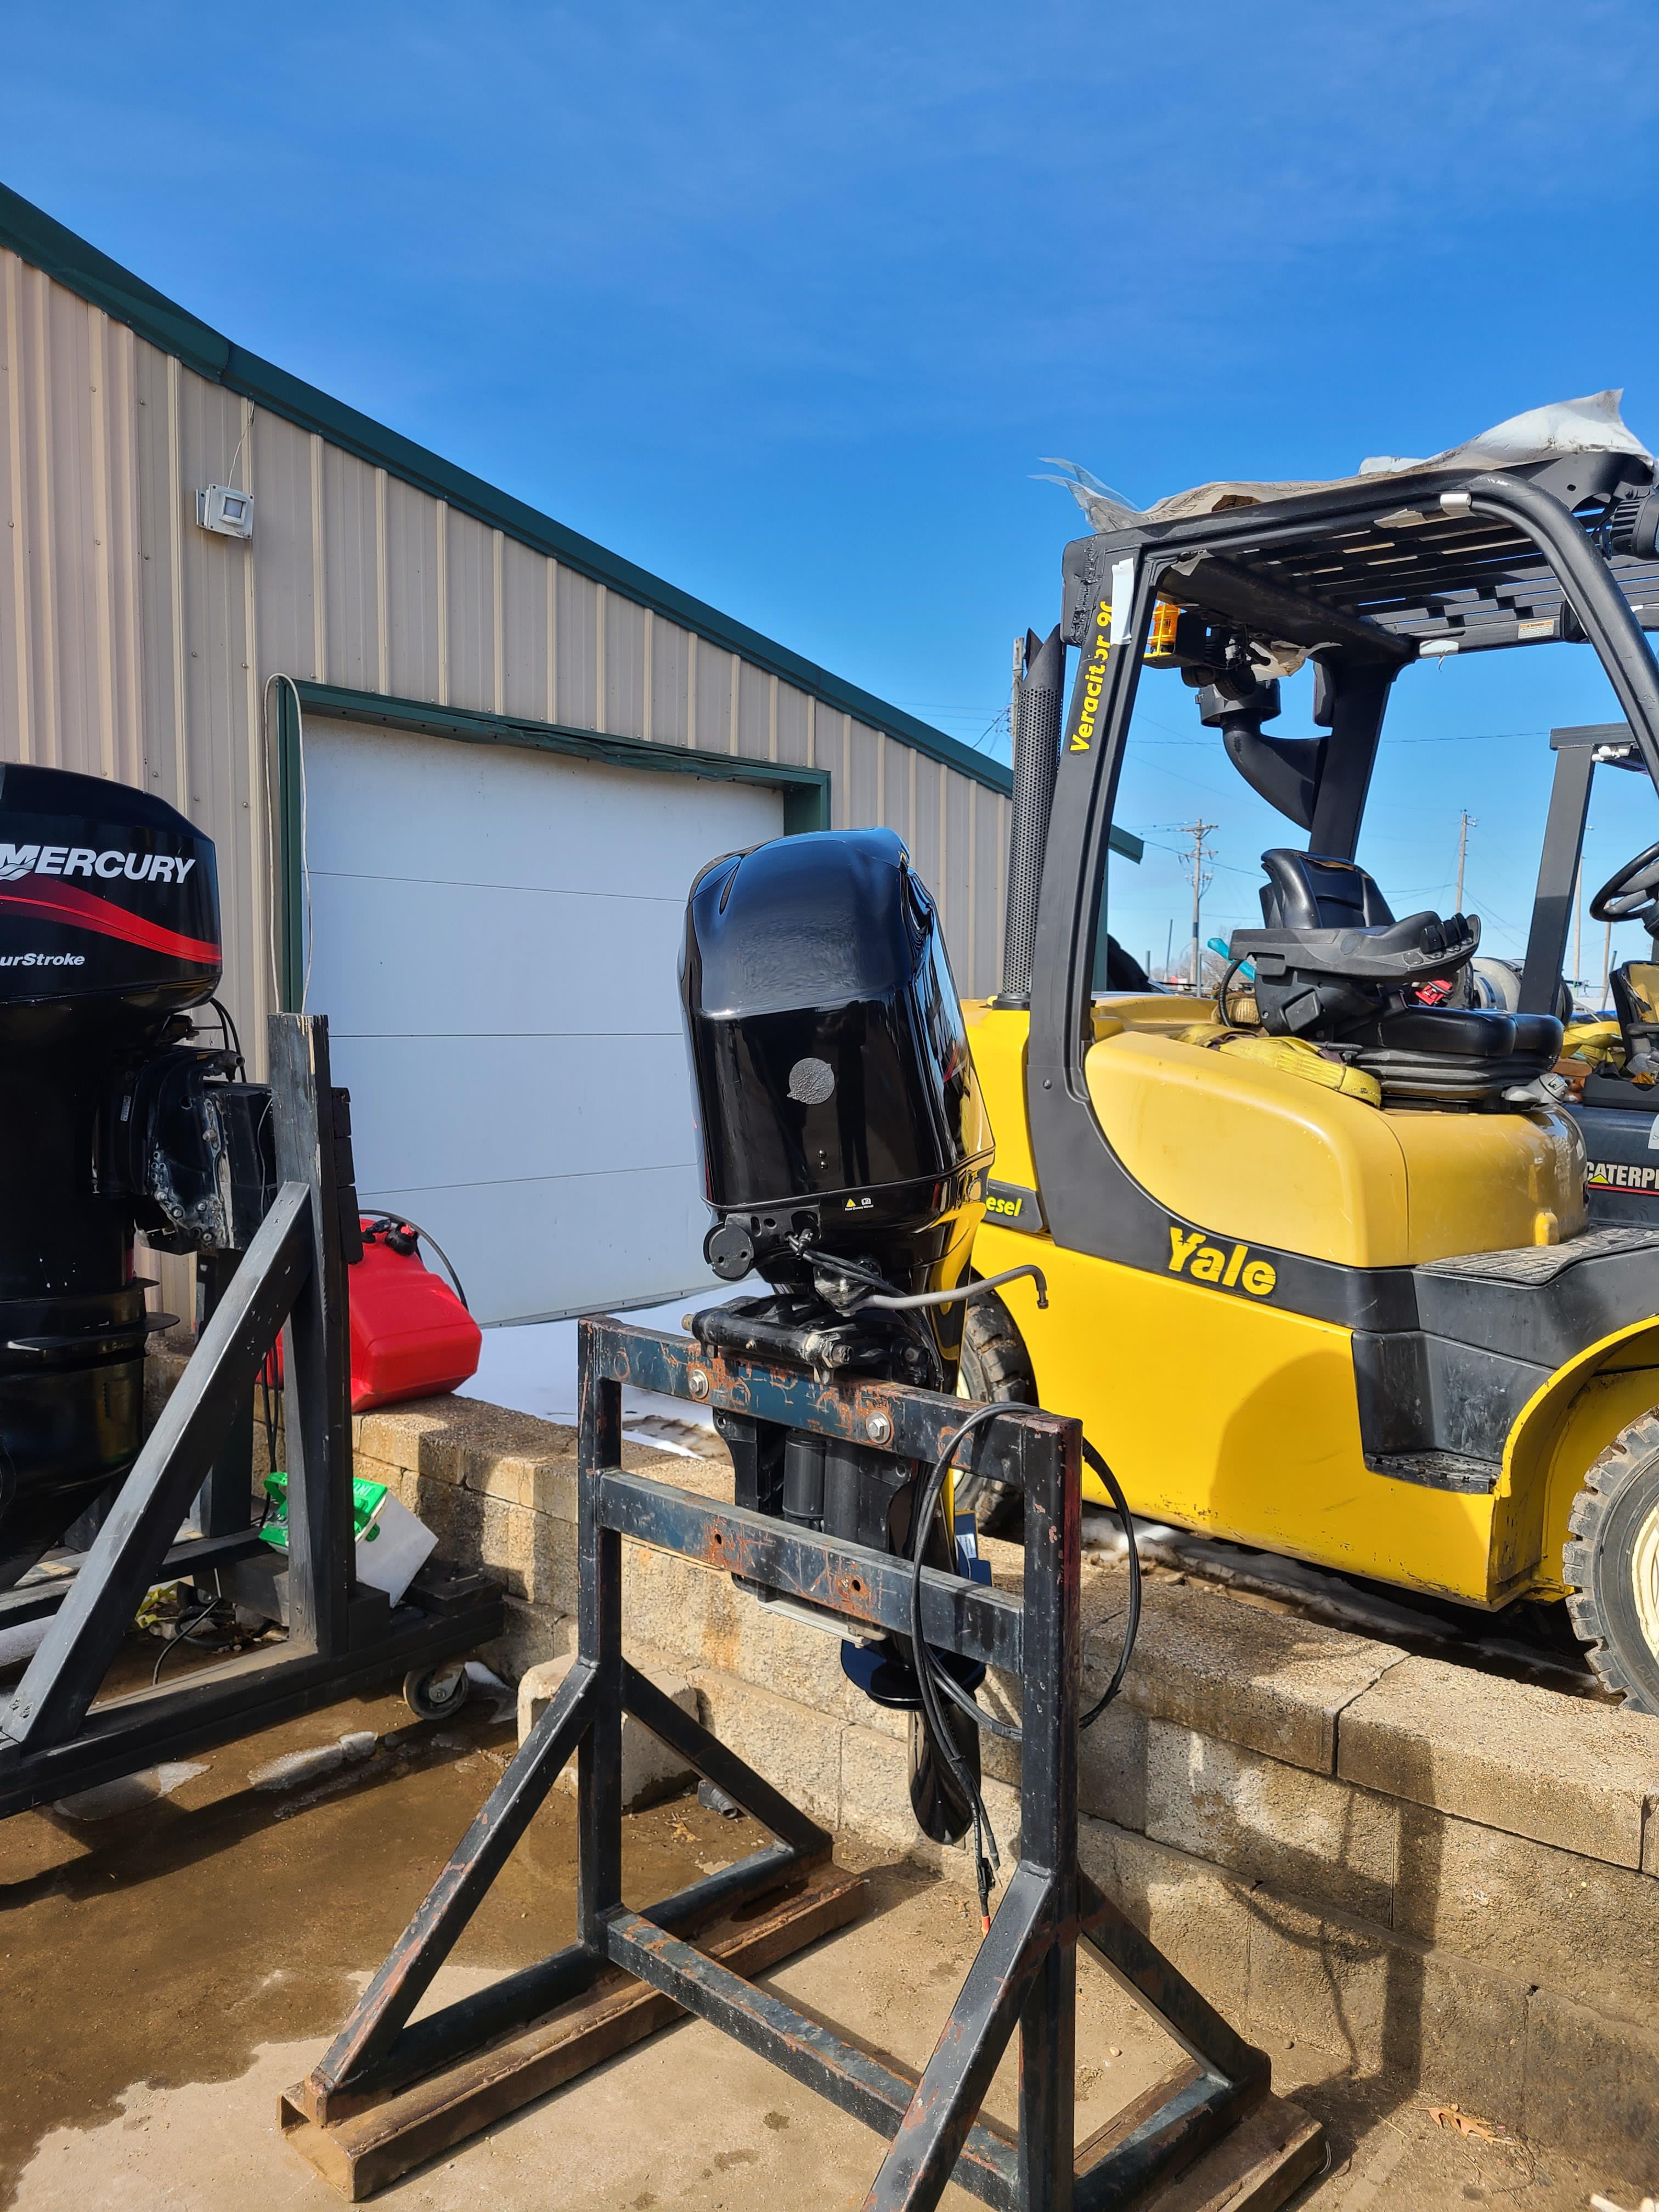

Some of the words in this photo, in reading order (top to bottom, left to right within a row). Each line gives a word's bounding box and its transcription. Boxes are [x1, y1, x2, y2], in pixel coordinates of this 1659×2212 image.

[0, 843, 196, 883] MERCURY
[986, 1197, 1023, 1217] esel
[1168, 1226, 1276, 1296] Yale
